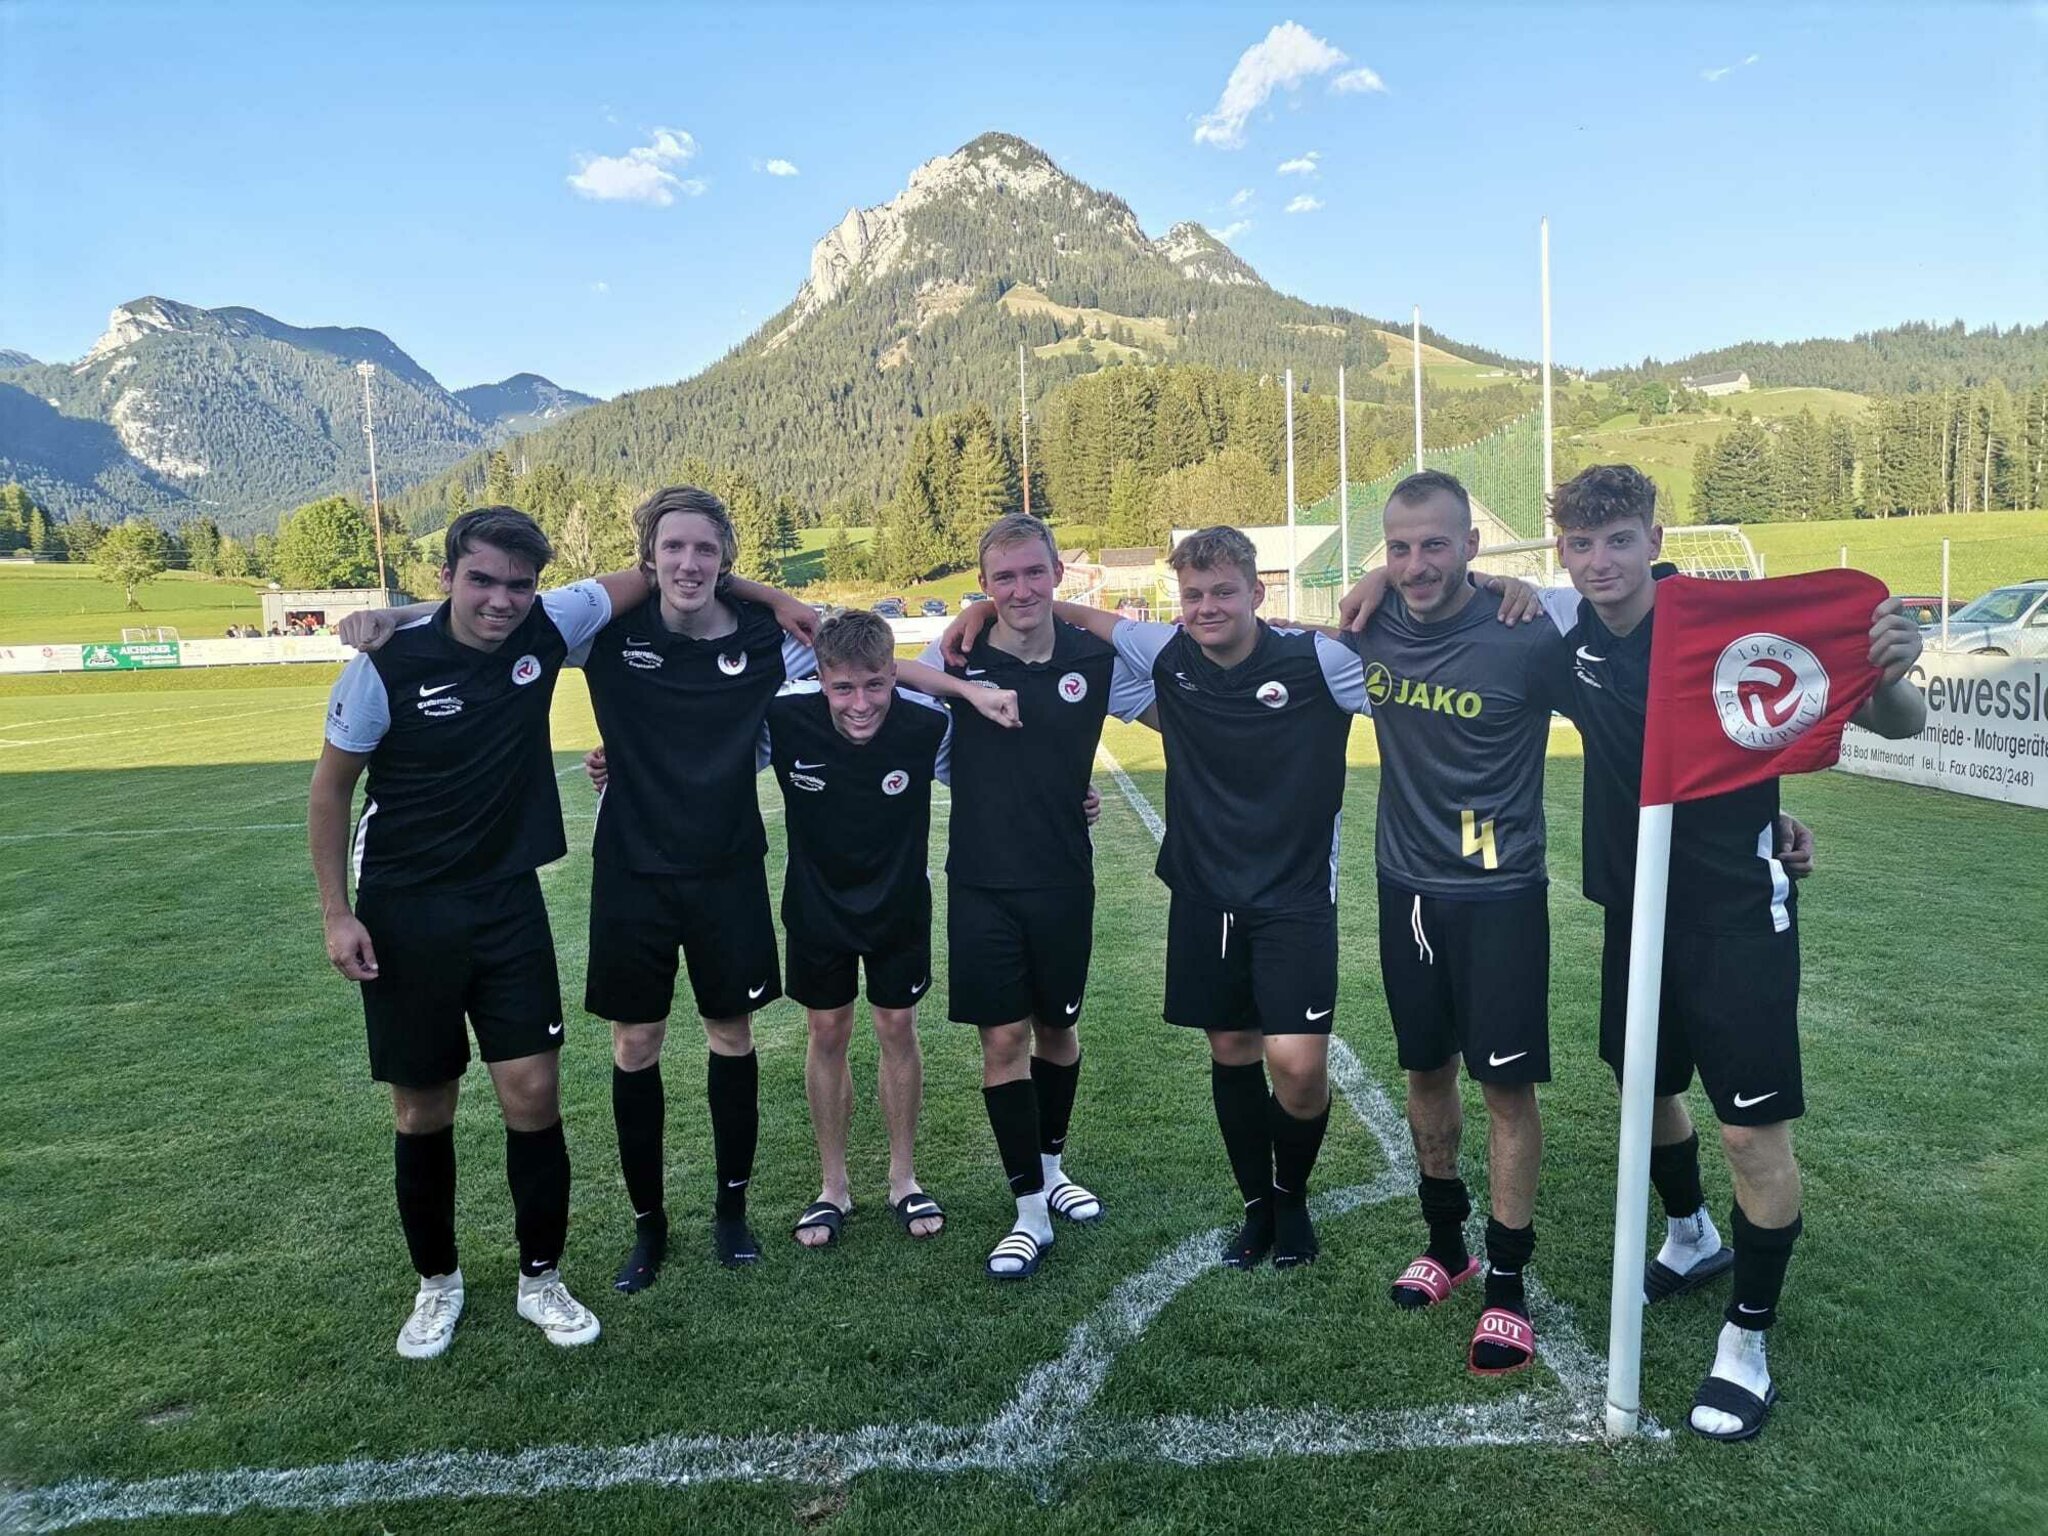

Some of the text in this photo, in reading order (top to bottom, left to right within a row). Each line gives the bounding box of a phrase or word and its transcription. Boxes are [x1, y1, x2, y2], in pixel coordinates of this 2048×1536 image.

[1738, 643, 1794, 661] 1966
[1395, 678, 1483, 719] JAKO
[1853, 745, 1868, 760] Bad
[1871, 748, 1915, 767] Mitterndorf
[1950, 760, 1967, 776] Fax
[1969, 763, 2034, 787] 03623/2481
[1461, 809, 1498, 869] 4
[1401, 1265, 1438, 1286] HILL
[1483, 1317, 1522, 1339] OUT
